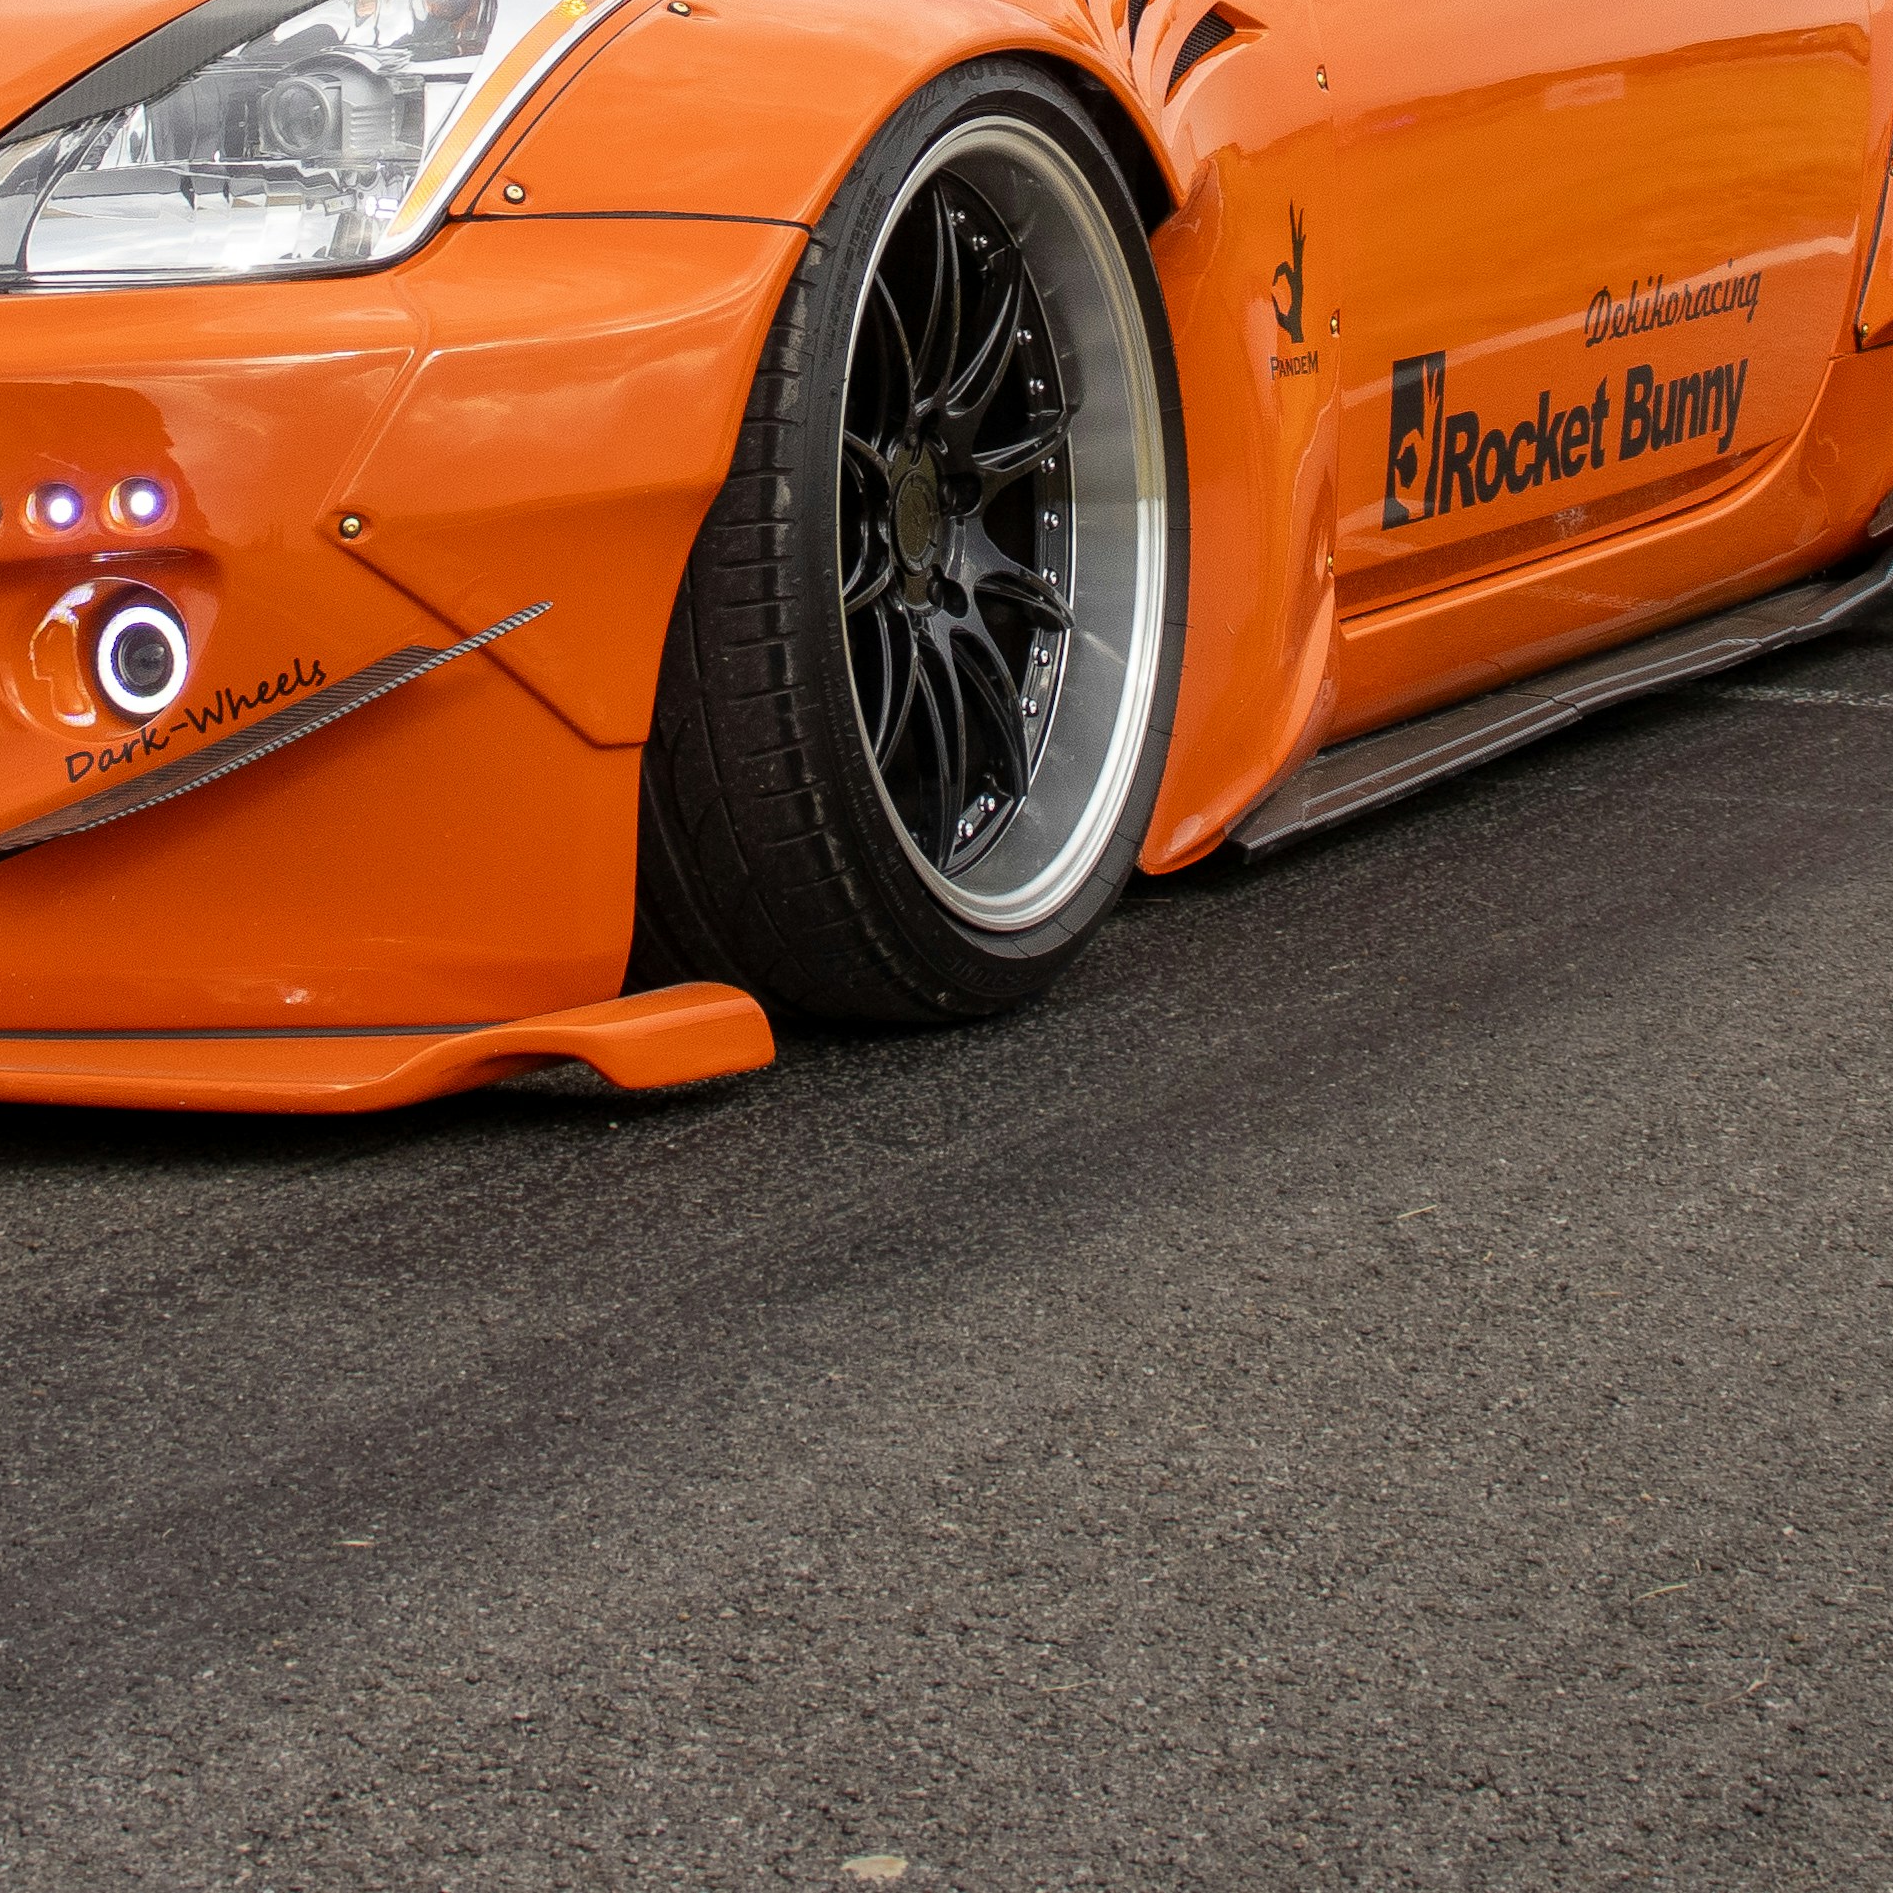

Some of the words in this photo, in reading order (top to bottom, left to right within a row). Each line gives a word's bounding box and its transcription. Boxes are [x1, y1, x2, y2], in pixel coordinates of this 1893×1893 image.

[1584, 258, 1762, 348] Dekikoracing
[1439, 375, 1610, 515] Rocket
[1619, 358, 1749, 462] Bunny
[65, 657, 328, 783] Dark-Wheels
